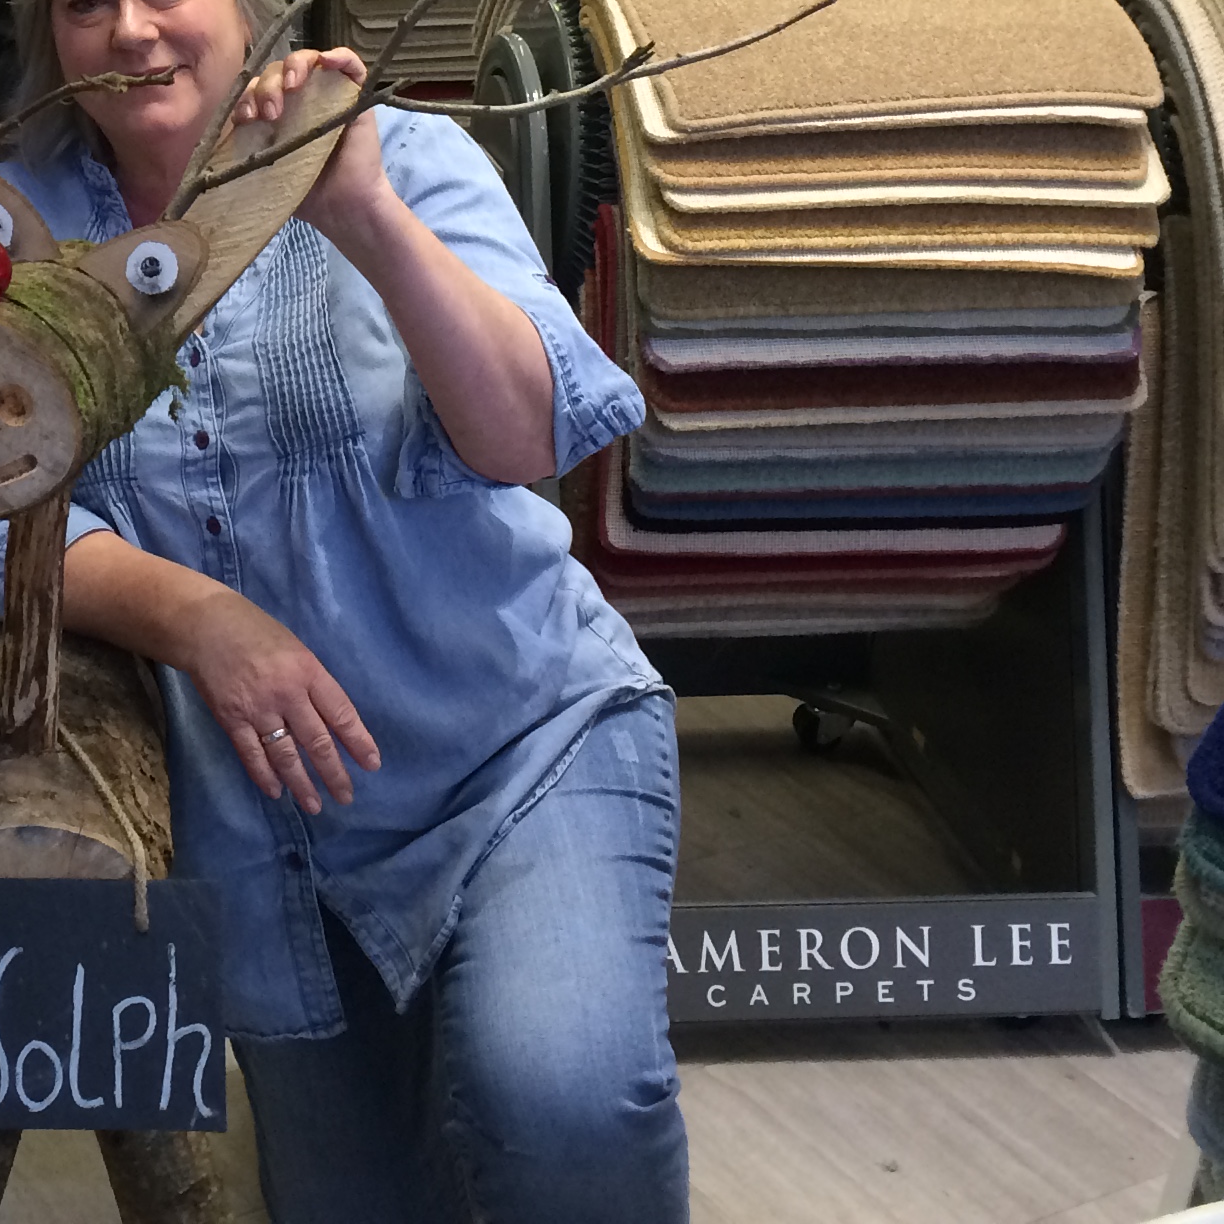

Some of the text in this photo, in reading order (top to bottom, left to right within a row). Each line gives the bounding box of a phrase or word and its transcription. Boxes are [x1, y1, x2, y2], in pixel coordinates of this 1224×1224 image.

[666, 922, 1073, 974] AMERON LEE
[707, 979, 976, 1008] CARPETS
